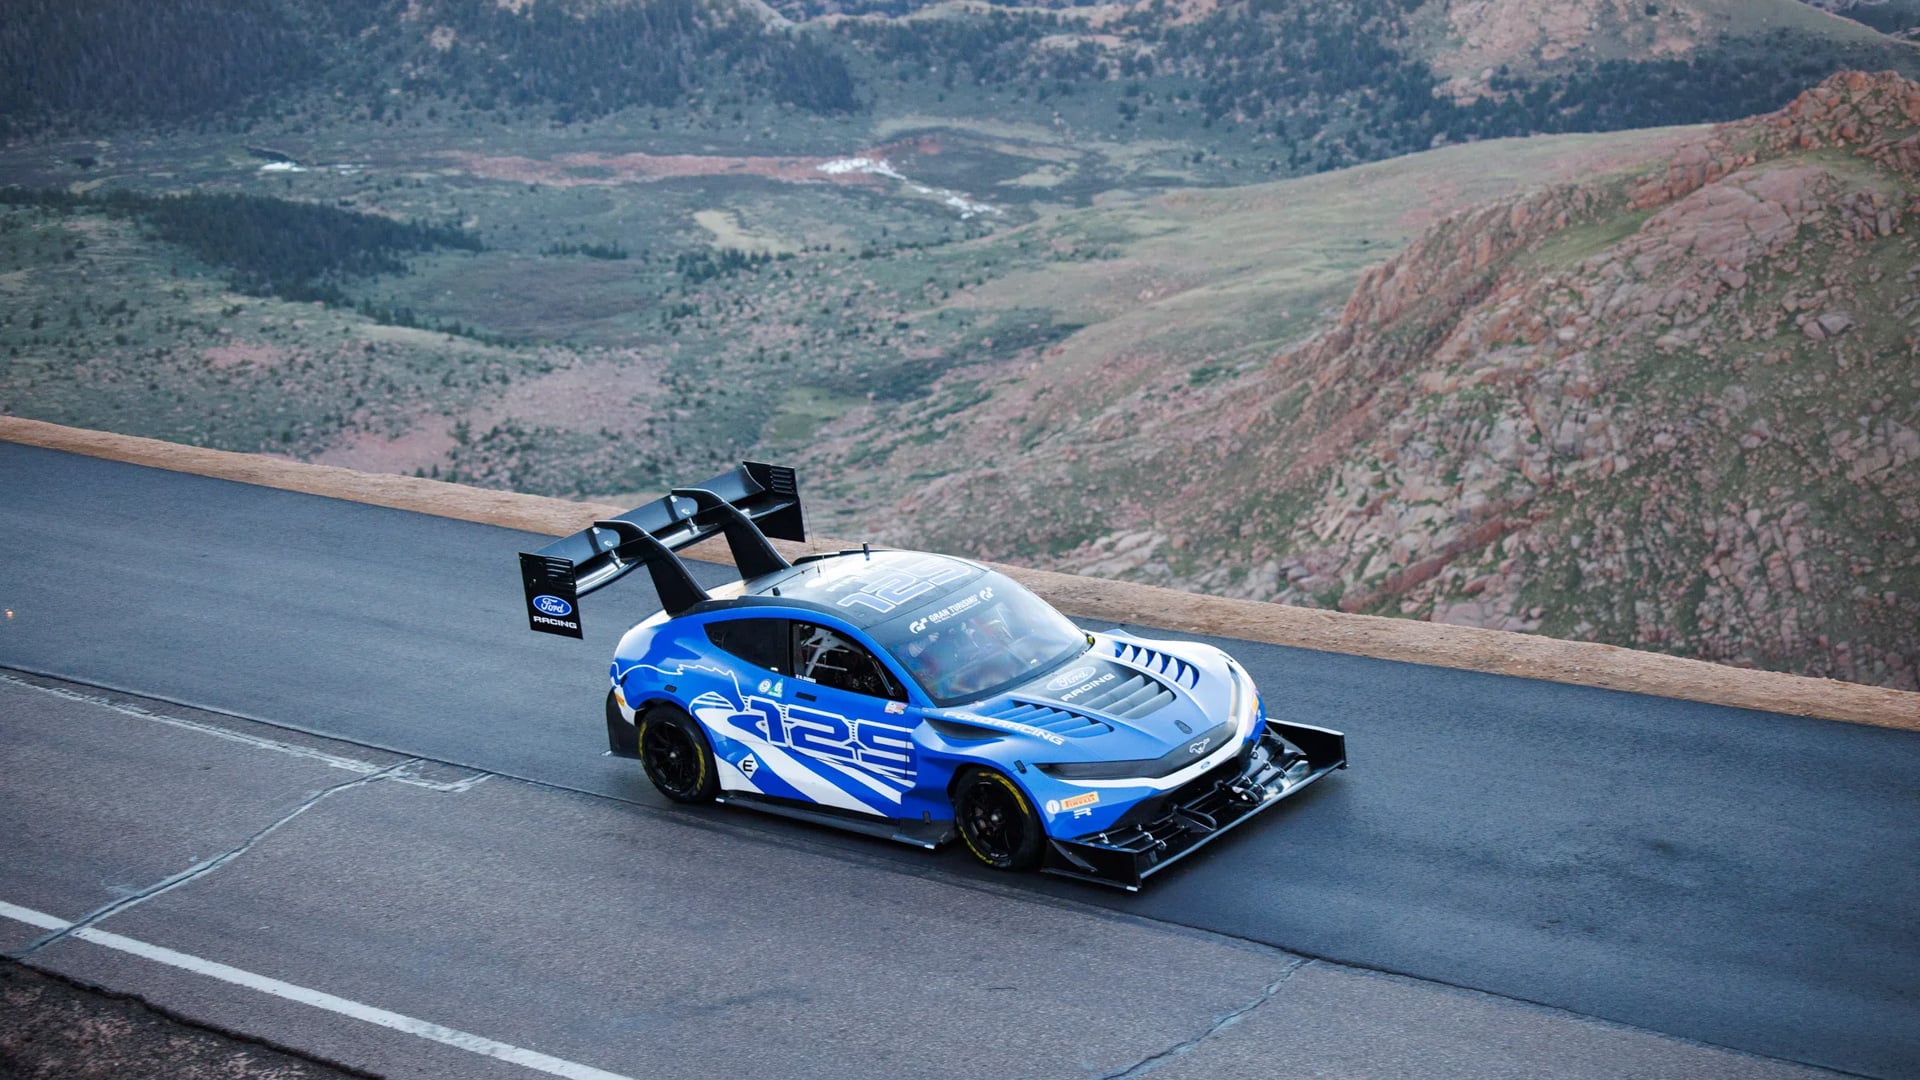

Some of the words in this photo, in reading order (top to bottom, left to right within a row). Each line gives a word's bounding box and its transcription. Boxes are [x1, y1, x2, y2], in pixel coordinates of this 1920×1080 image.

[835, 557, 972, 613] 125
[541, 597, 565, 613] Ford
[533, 615, 577, 629] RACING
[928, 608, 950, 622] GRAN
[1057, 670, 1089, 687] Ford
[1060, 673, 1116, 702] RACING
[750, 695, 917, 776] 125
[742, 759, 754, 772] E
